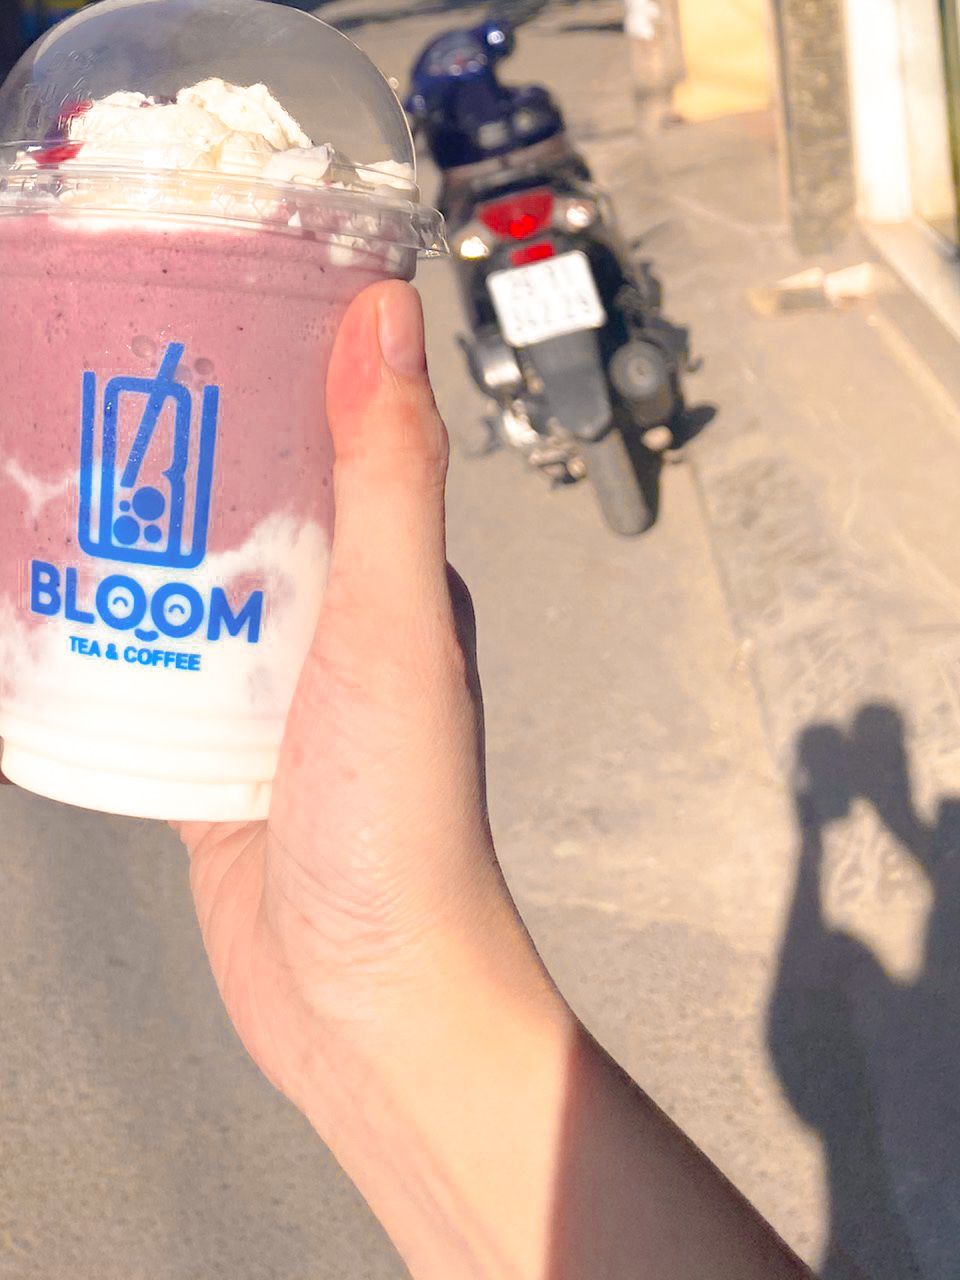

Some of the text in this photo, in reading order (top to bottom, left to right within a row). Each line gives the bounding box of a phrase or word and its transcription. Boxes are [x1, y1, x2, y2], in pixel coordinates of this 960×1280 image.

[30, 559, 264, 644] BLOOM
[69, 636, 202, 671] TEA & COFFEE
